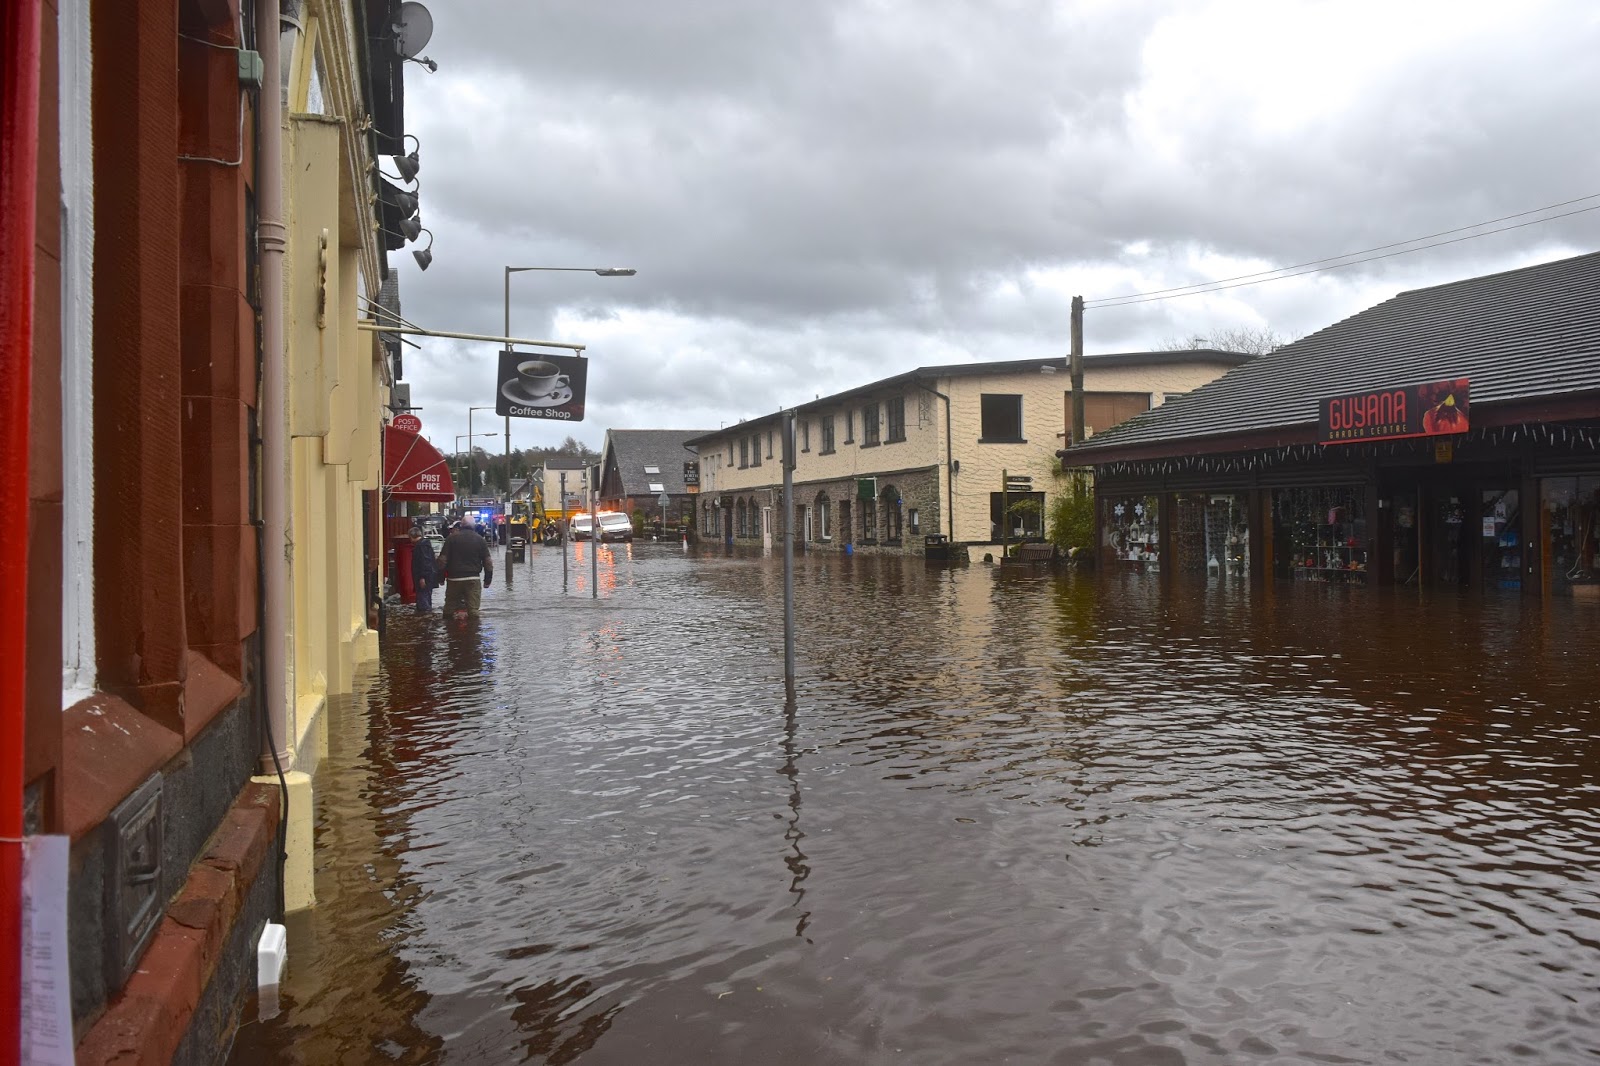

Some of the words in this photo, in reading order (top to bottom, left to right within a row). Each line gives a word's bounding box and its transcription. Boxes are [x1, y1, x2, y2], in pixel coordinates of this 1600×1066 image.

[509, 405, 542, 416] Coffee
[545, 408, 571, 419] Shop
[1329, 390, 1406, 430] GUYANA
[1329, 428, 1364, 439] GARDEN
[1371, 424, 1406, 435] CENTRE
[416, 482, 440, 490] OFFICE
